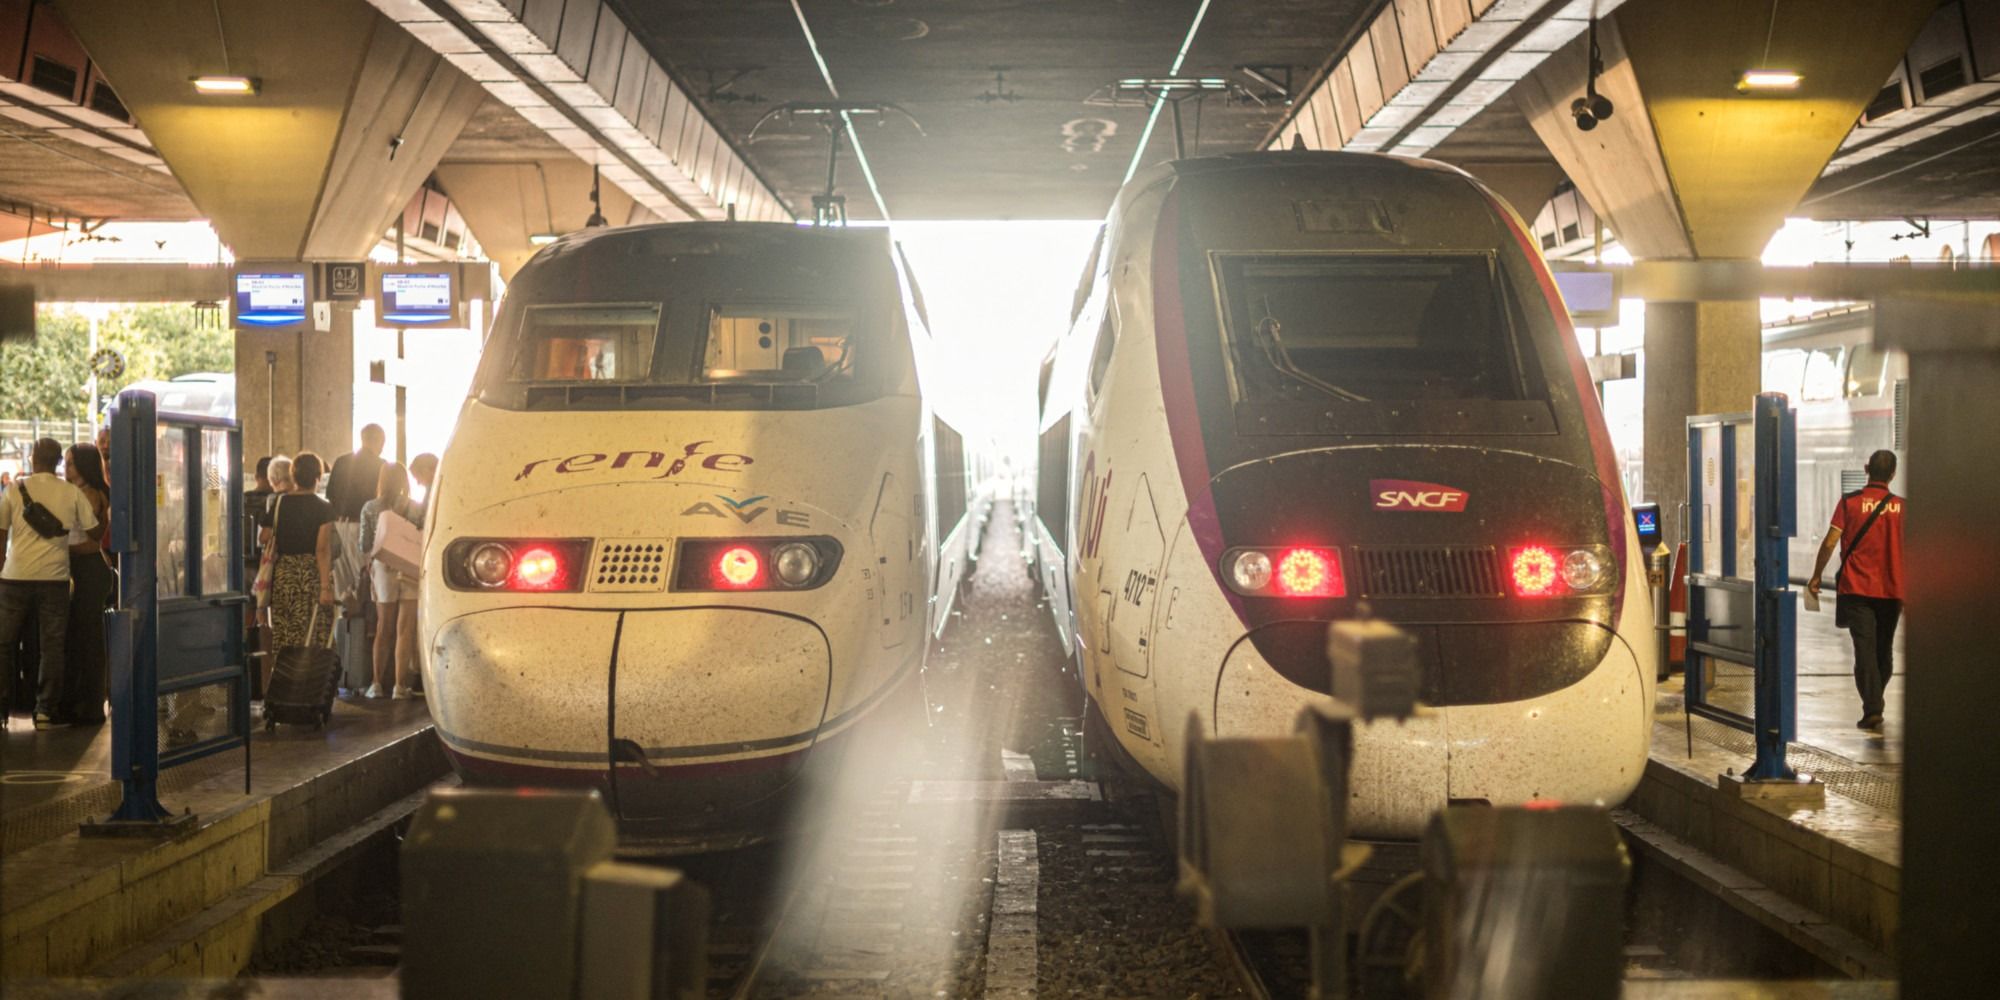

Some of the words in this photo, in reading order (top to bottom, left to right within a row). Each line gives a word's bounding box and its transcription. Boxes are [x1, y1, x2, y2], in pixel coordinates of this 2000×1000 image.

[514, 440, 754, 481] renfe
[680, 494, 810, 529] AVE
[1375, 490, 1462, 508] SNCF
[1124, 569, 1147, 607] 4712
[1650, 573, 1663, 584] 21
